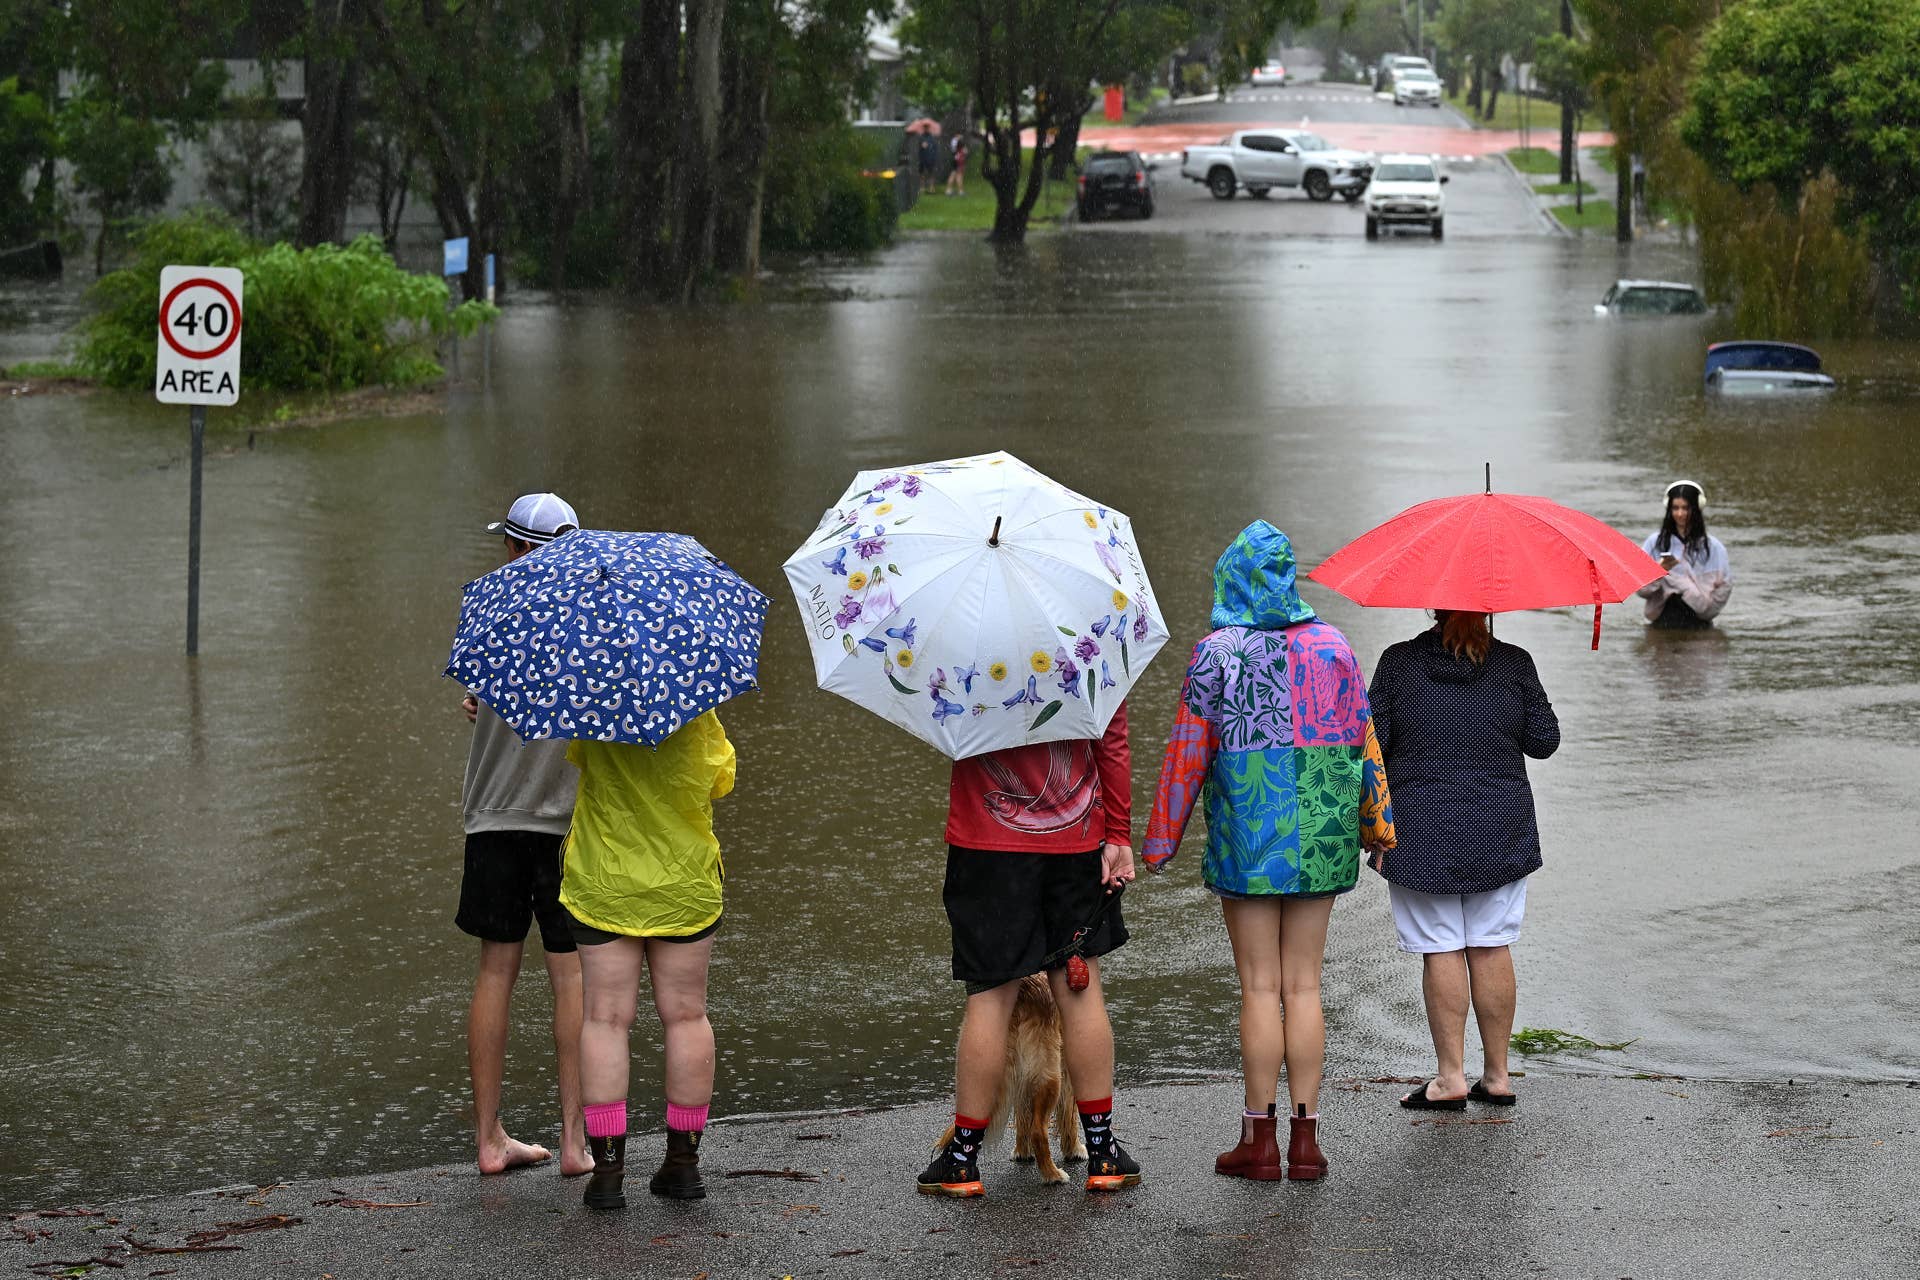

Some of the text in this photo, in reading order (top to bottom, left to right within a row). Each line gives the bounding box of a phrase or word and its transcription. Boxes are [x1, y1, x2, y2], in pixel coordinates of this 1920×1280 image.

[174, 302, 228, 337] 40
[160, 369, 235, 394] AREA
[809, 584, 835, 640] NATIO
